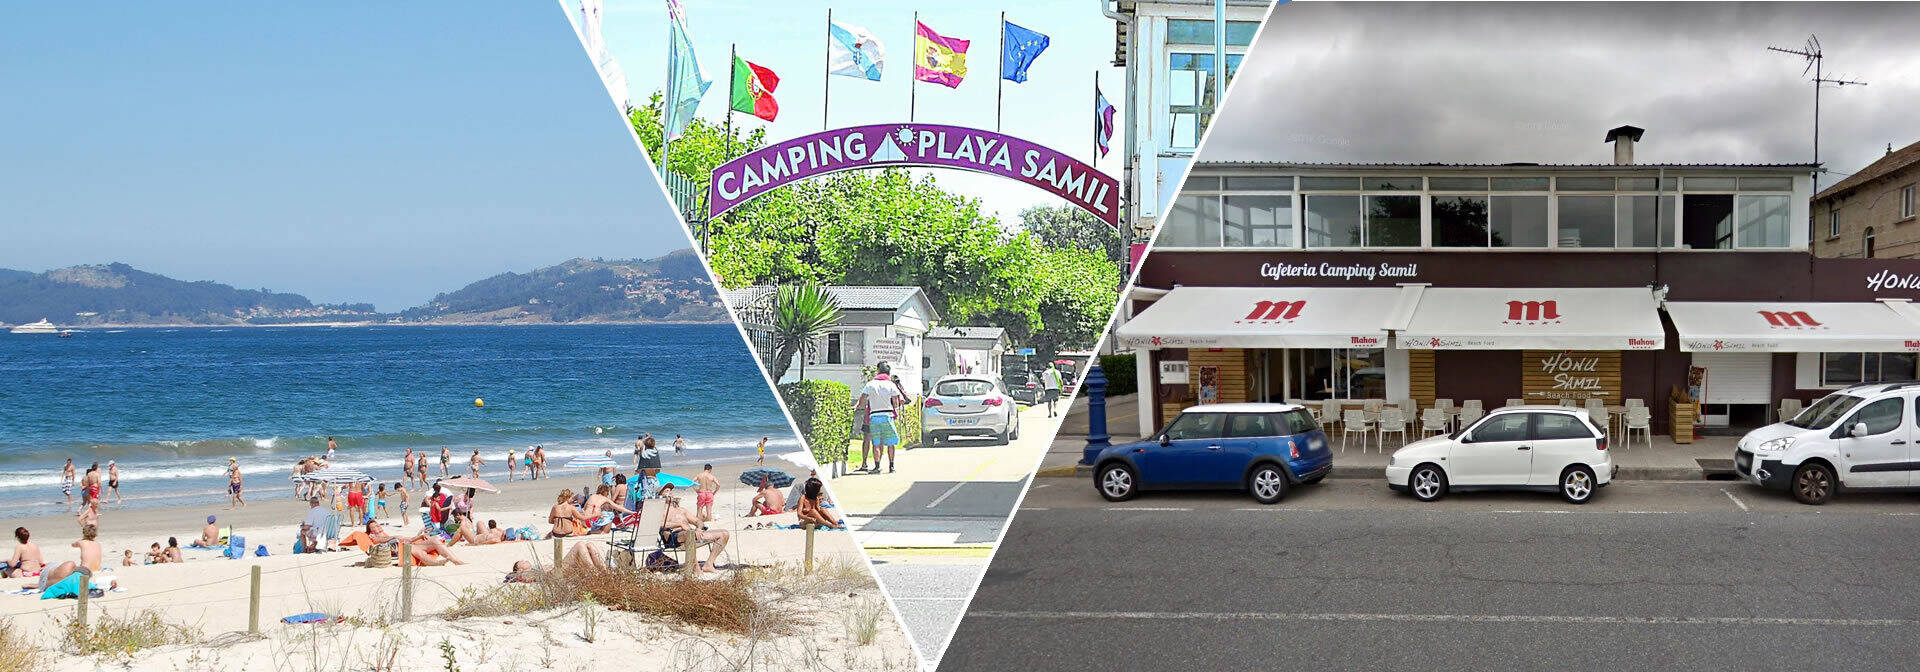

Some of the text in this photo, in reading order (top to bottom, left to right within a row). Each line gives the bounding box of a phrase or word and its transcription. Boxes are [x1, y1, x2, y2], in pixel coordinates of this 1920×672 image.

[717, 131, 1110, 215] CAMPING PLAYA SAMIL
[1261, 262, 1418, 280] Cafeteria Camping Samil
[1351, 336, 1378, 344] Mahou
[1628, 338, 1655, 346] Mahou
[1541, 352, 1599, 374] HONU
[1552, 372, 1602, 390] SAMIL
[1546, 391, 1592, 399] Beach Food
